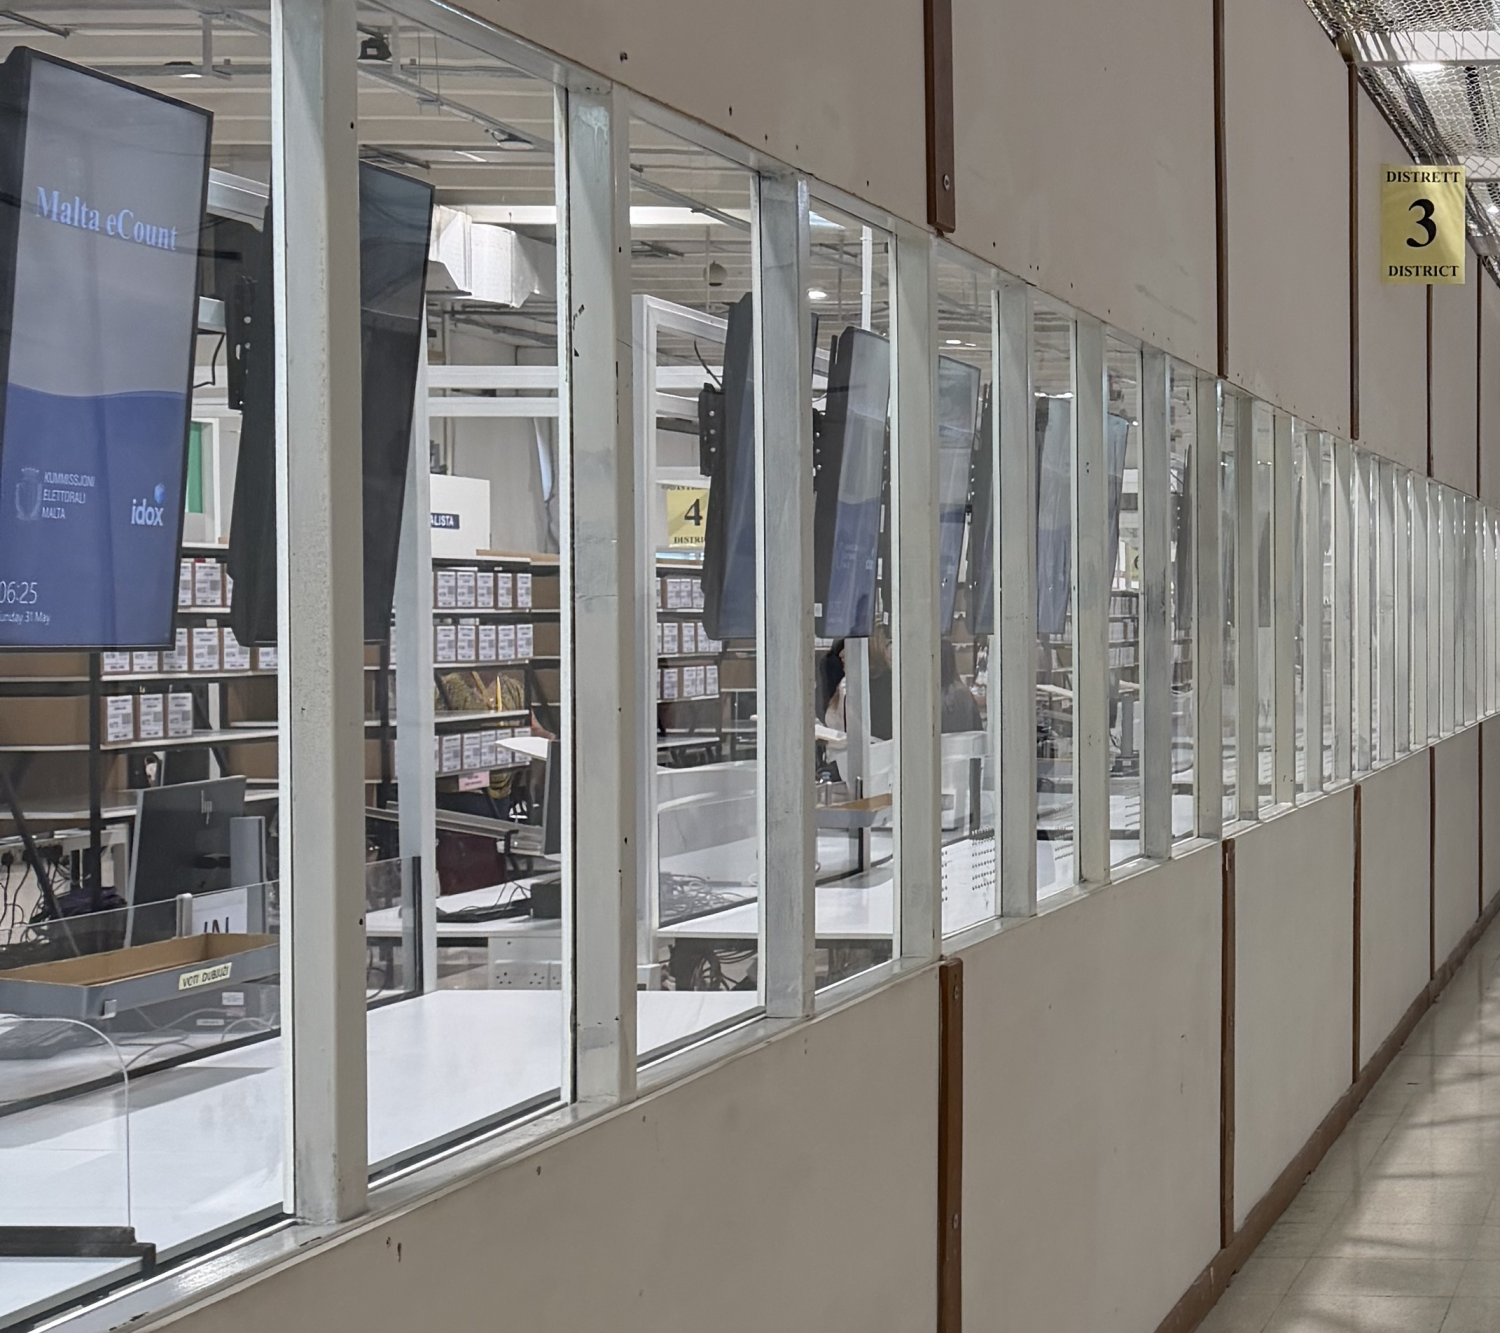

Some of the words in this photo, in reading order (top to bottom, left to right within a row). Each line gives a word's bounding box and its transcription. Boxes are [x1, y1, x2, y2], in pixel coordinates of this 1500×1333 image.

[1386, 171, 1461, 183] DISTRETT
[36, 186, 100, 231] Malta
[106, 209, 178, 251] eCount
[1406, 198, 1437, 248] 3
[1388, 265, 1459, 277] DISTRICT
[41, 506, 67, 520] MALTA
[131, 498, 164, 527] idox
[684, 498, 703, 526] 4
